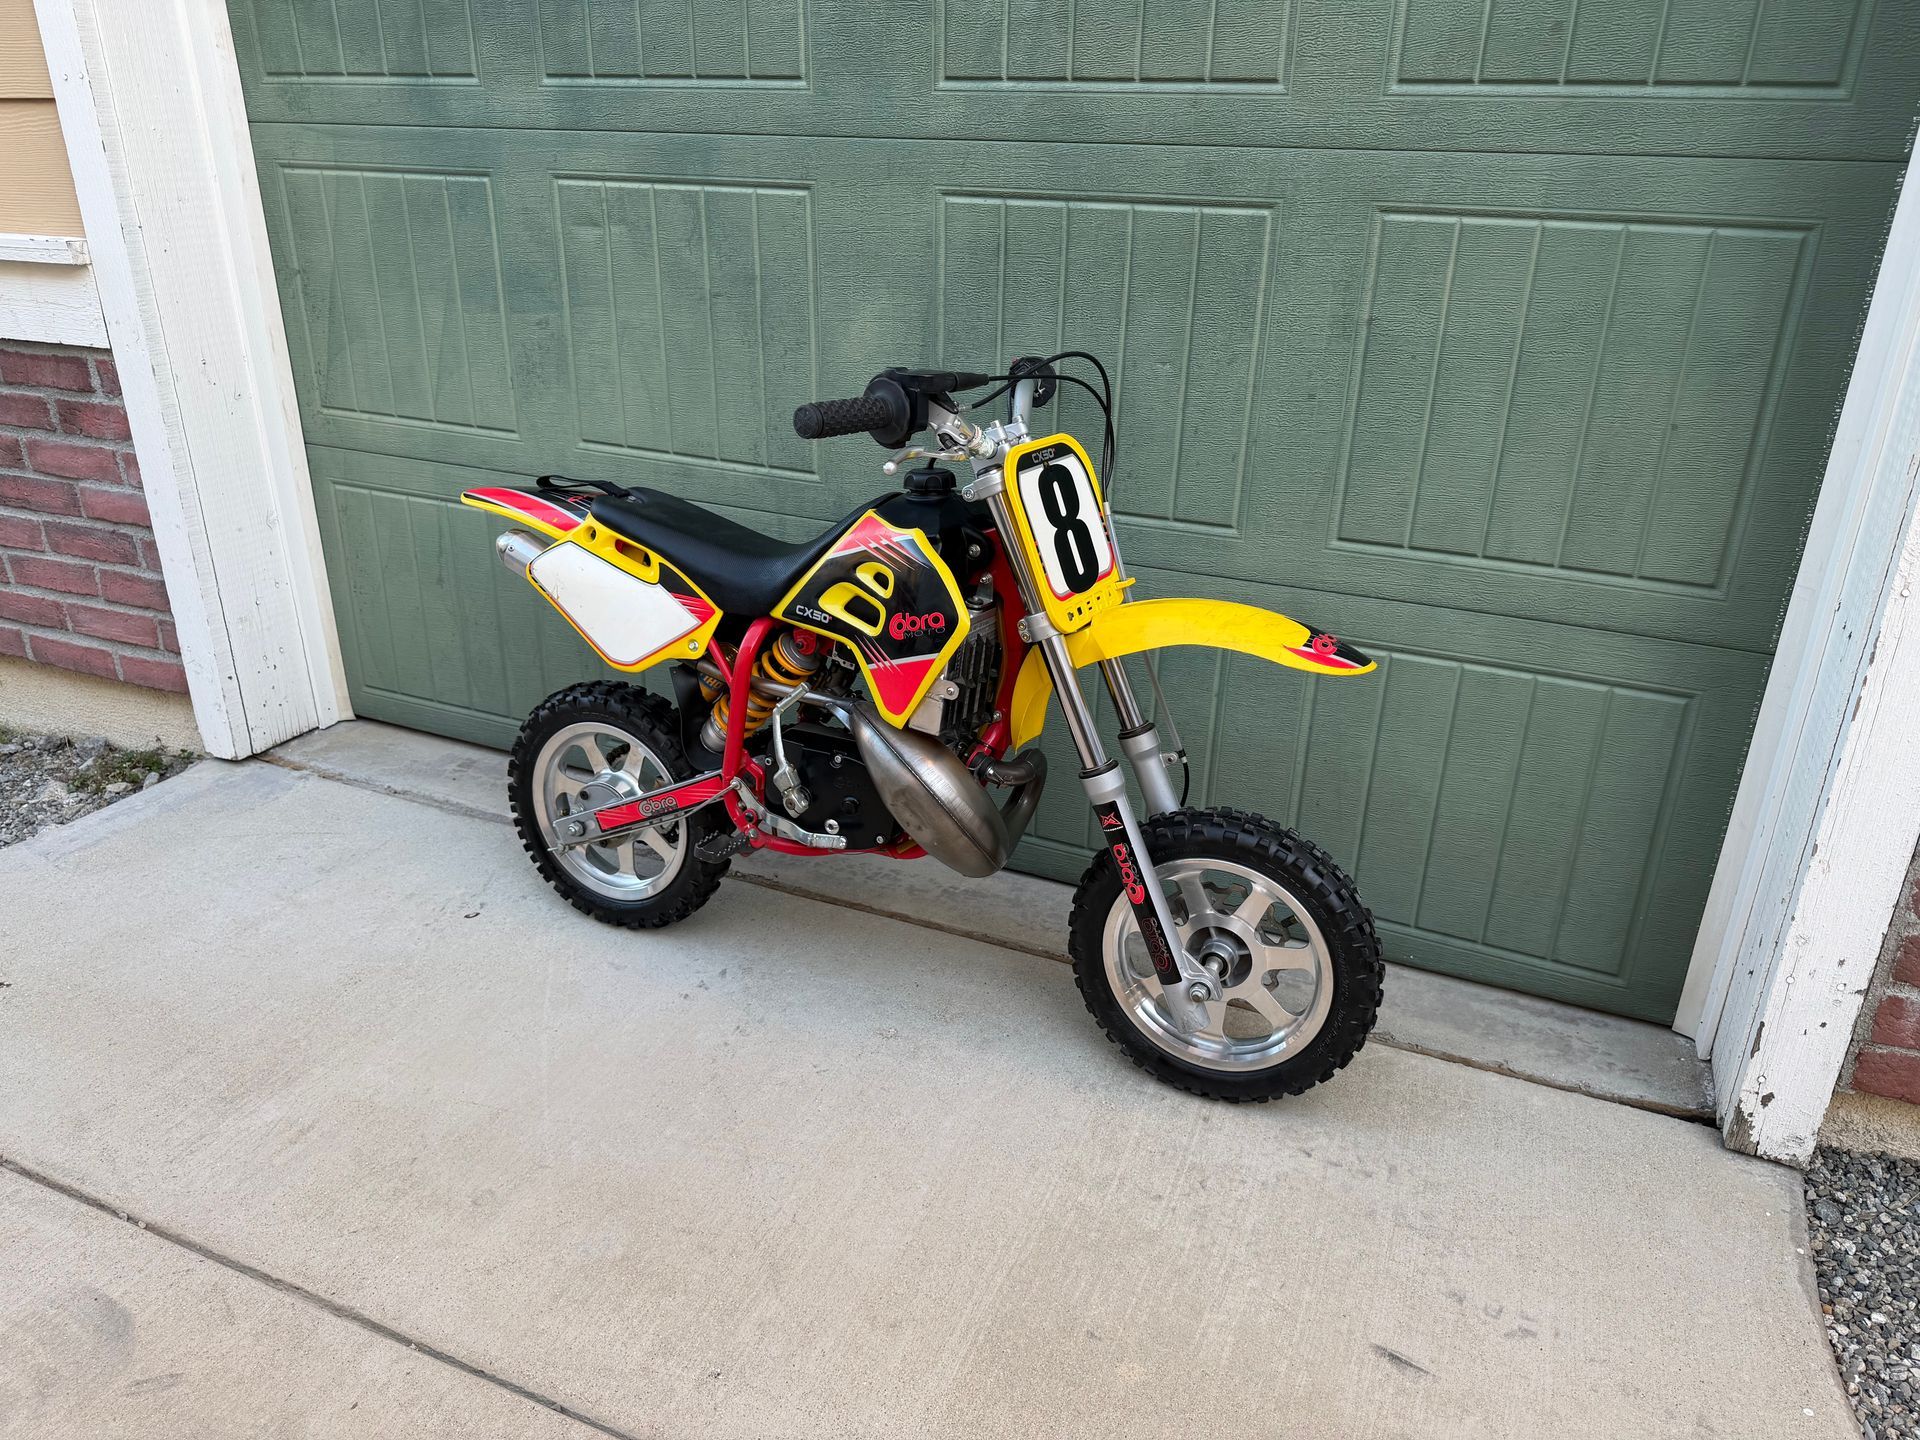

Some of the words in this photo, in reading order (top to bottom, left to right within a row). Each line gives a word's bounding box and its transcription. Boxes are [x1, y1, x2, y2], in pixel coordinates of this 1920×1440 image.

[1038, 463, 1100, 594] 8
[888, 611, 946, 641] Cobra
[904, 626, 946, 639] MOTO
[1113, 843, 1146, 905] Cobra
